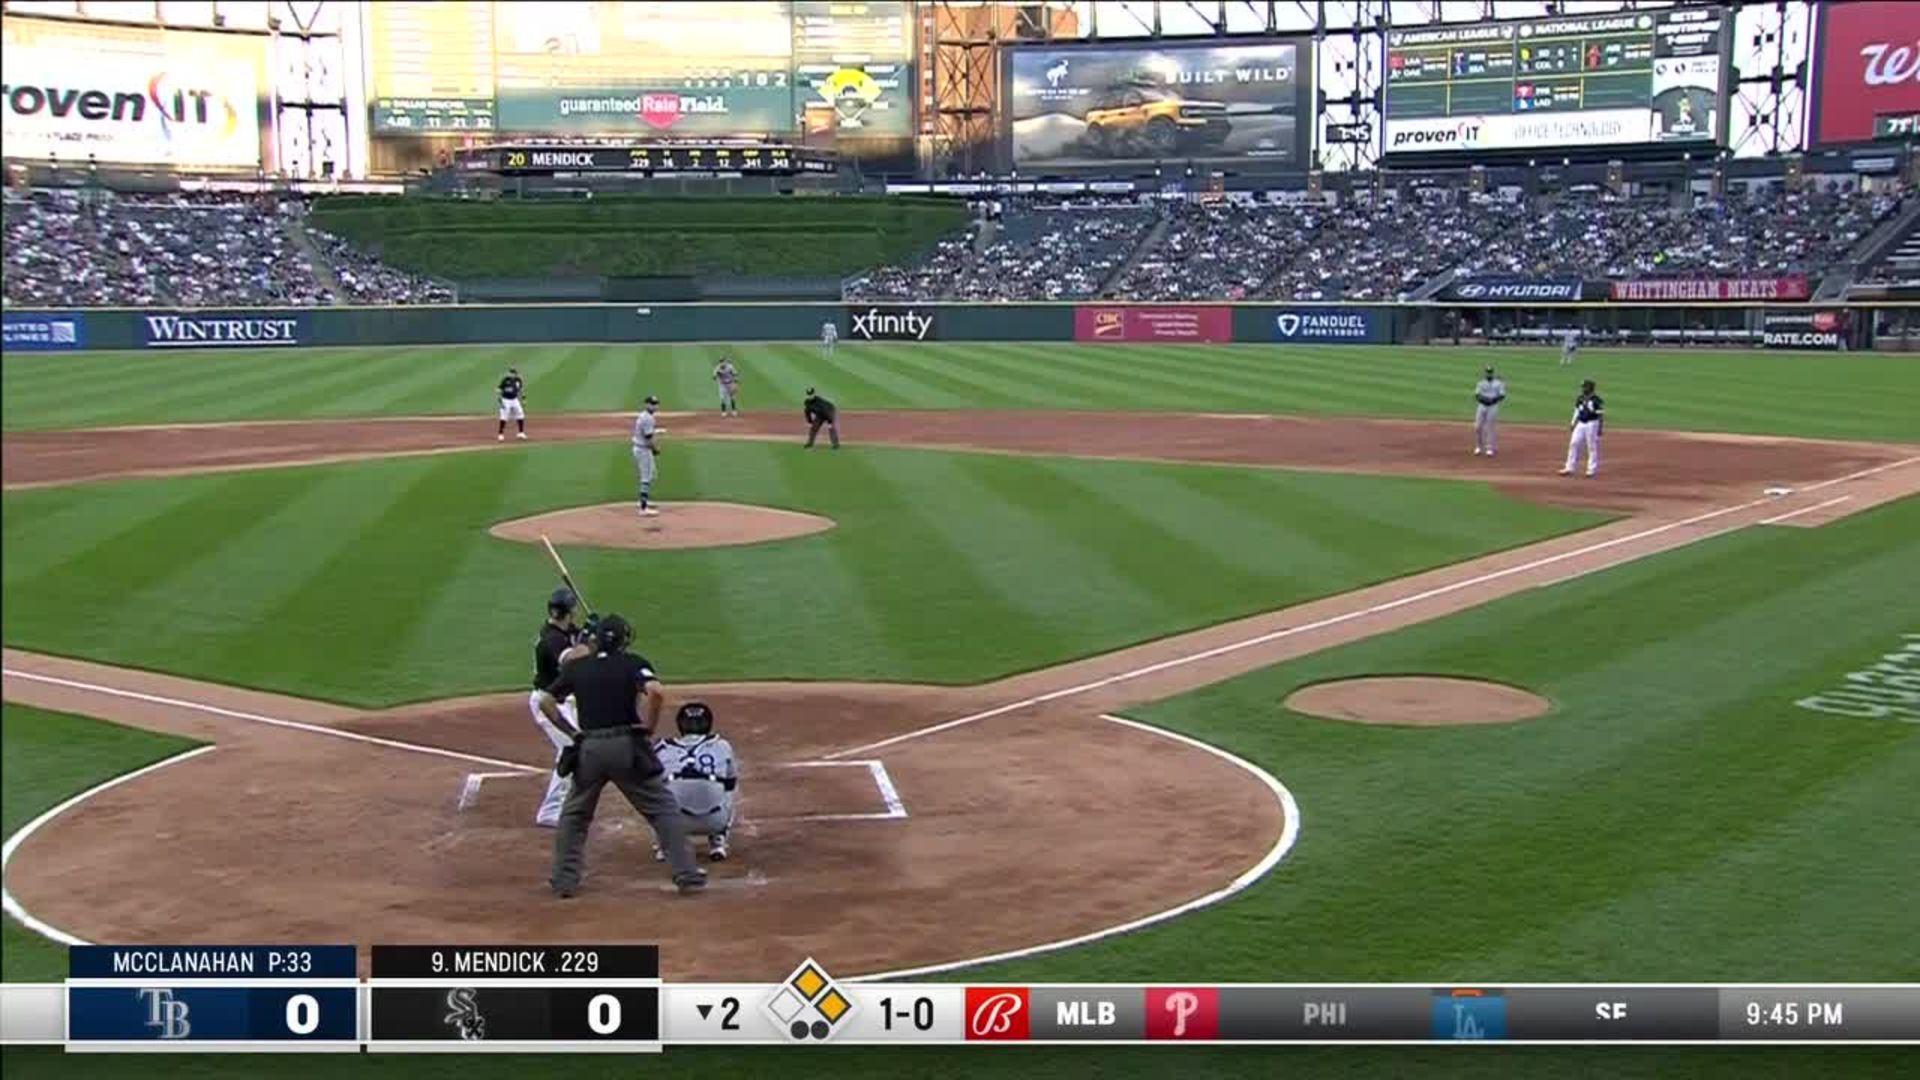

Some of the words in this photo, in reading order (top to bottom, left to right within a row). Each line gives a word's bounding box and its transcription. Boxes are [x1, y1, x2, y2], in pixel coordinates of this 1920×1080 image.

[1235, 67, 1289, 82] WILD
[560, 97, 641, 114] guaranteed
[1394, 130, 1457, 146] proven
[1466, 126, 1480, 140] IT
[507, 152, 526, 166] 20
[532, 152, 595, 166] MENDICK
[1488, 285, 1571, 297] HYUNDAI
[1615, 280, 1720, 299] WHITTINGHAM
[1728, 280, 1778, 298] MEATS
[145, 316, 297, 339] WINTRUST
[852, 307, 934, 340] xfinity
[1302, 315, 1366, 328] FANDUEL
[1763, 333, 1838, 345] RATE.COM
